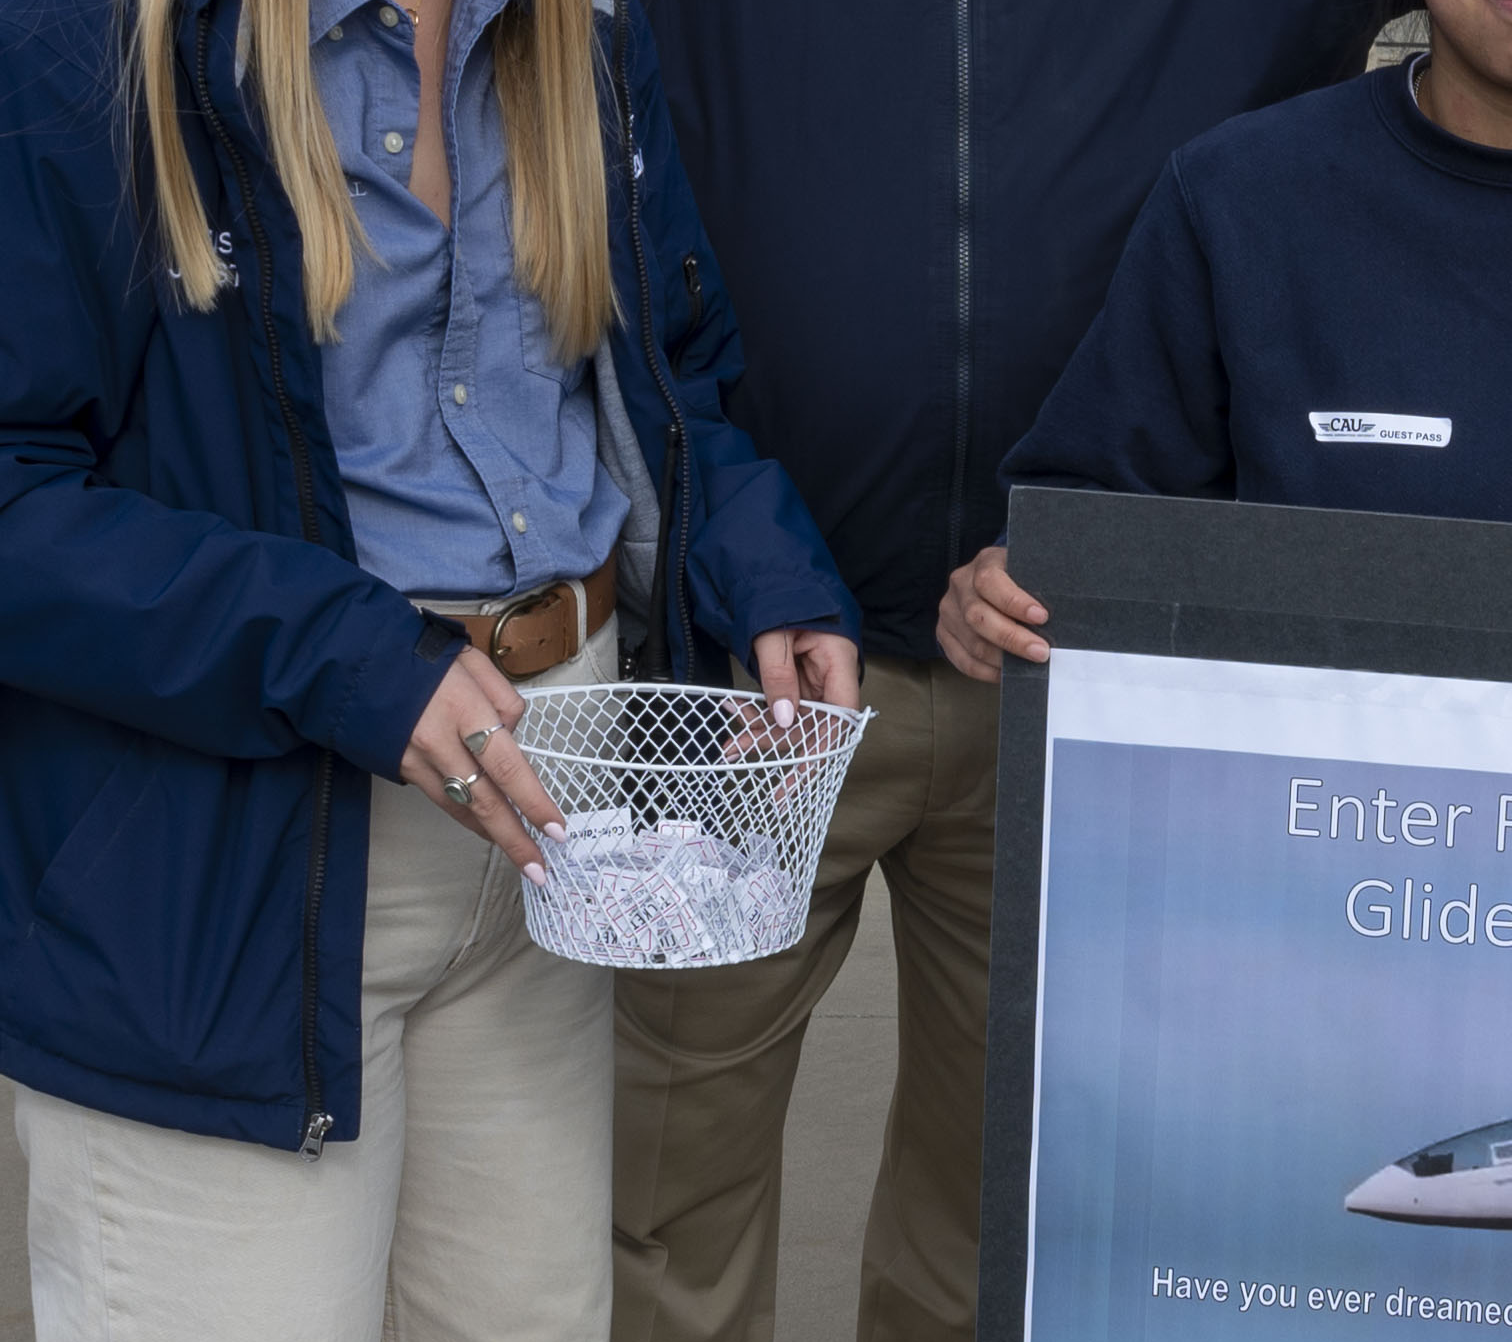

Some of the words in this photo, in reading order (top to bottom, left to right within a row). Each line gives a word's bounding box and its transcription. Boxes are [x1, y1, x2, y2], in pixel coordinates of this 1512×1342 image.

[1329, 417, 1364, 433] CAU
[1379, 429, 1413, 441] GUEST
[1415, 432, 1443, 443] PASS
[1286, 776, 1474, 849] Enter
[1151, 1265, 1231, 1304] Have
[1237, 1280, 1298, 1313] you
[1306, 1286, 1378, 1315] ever
